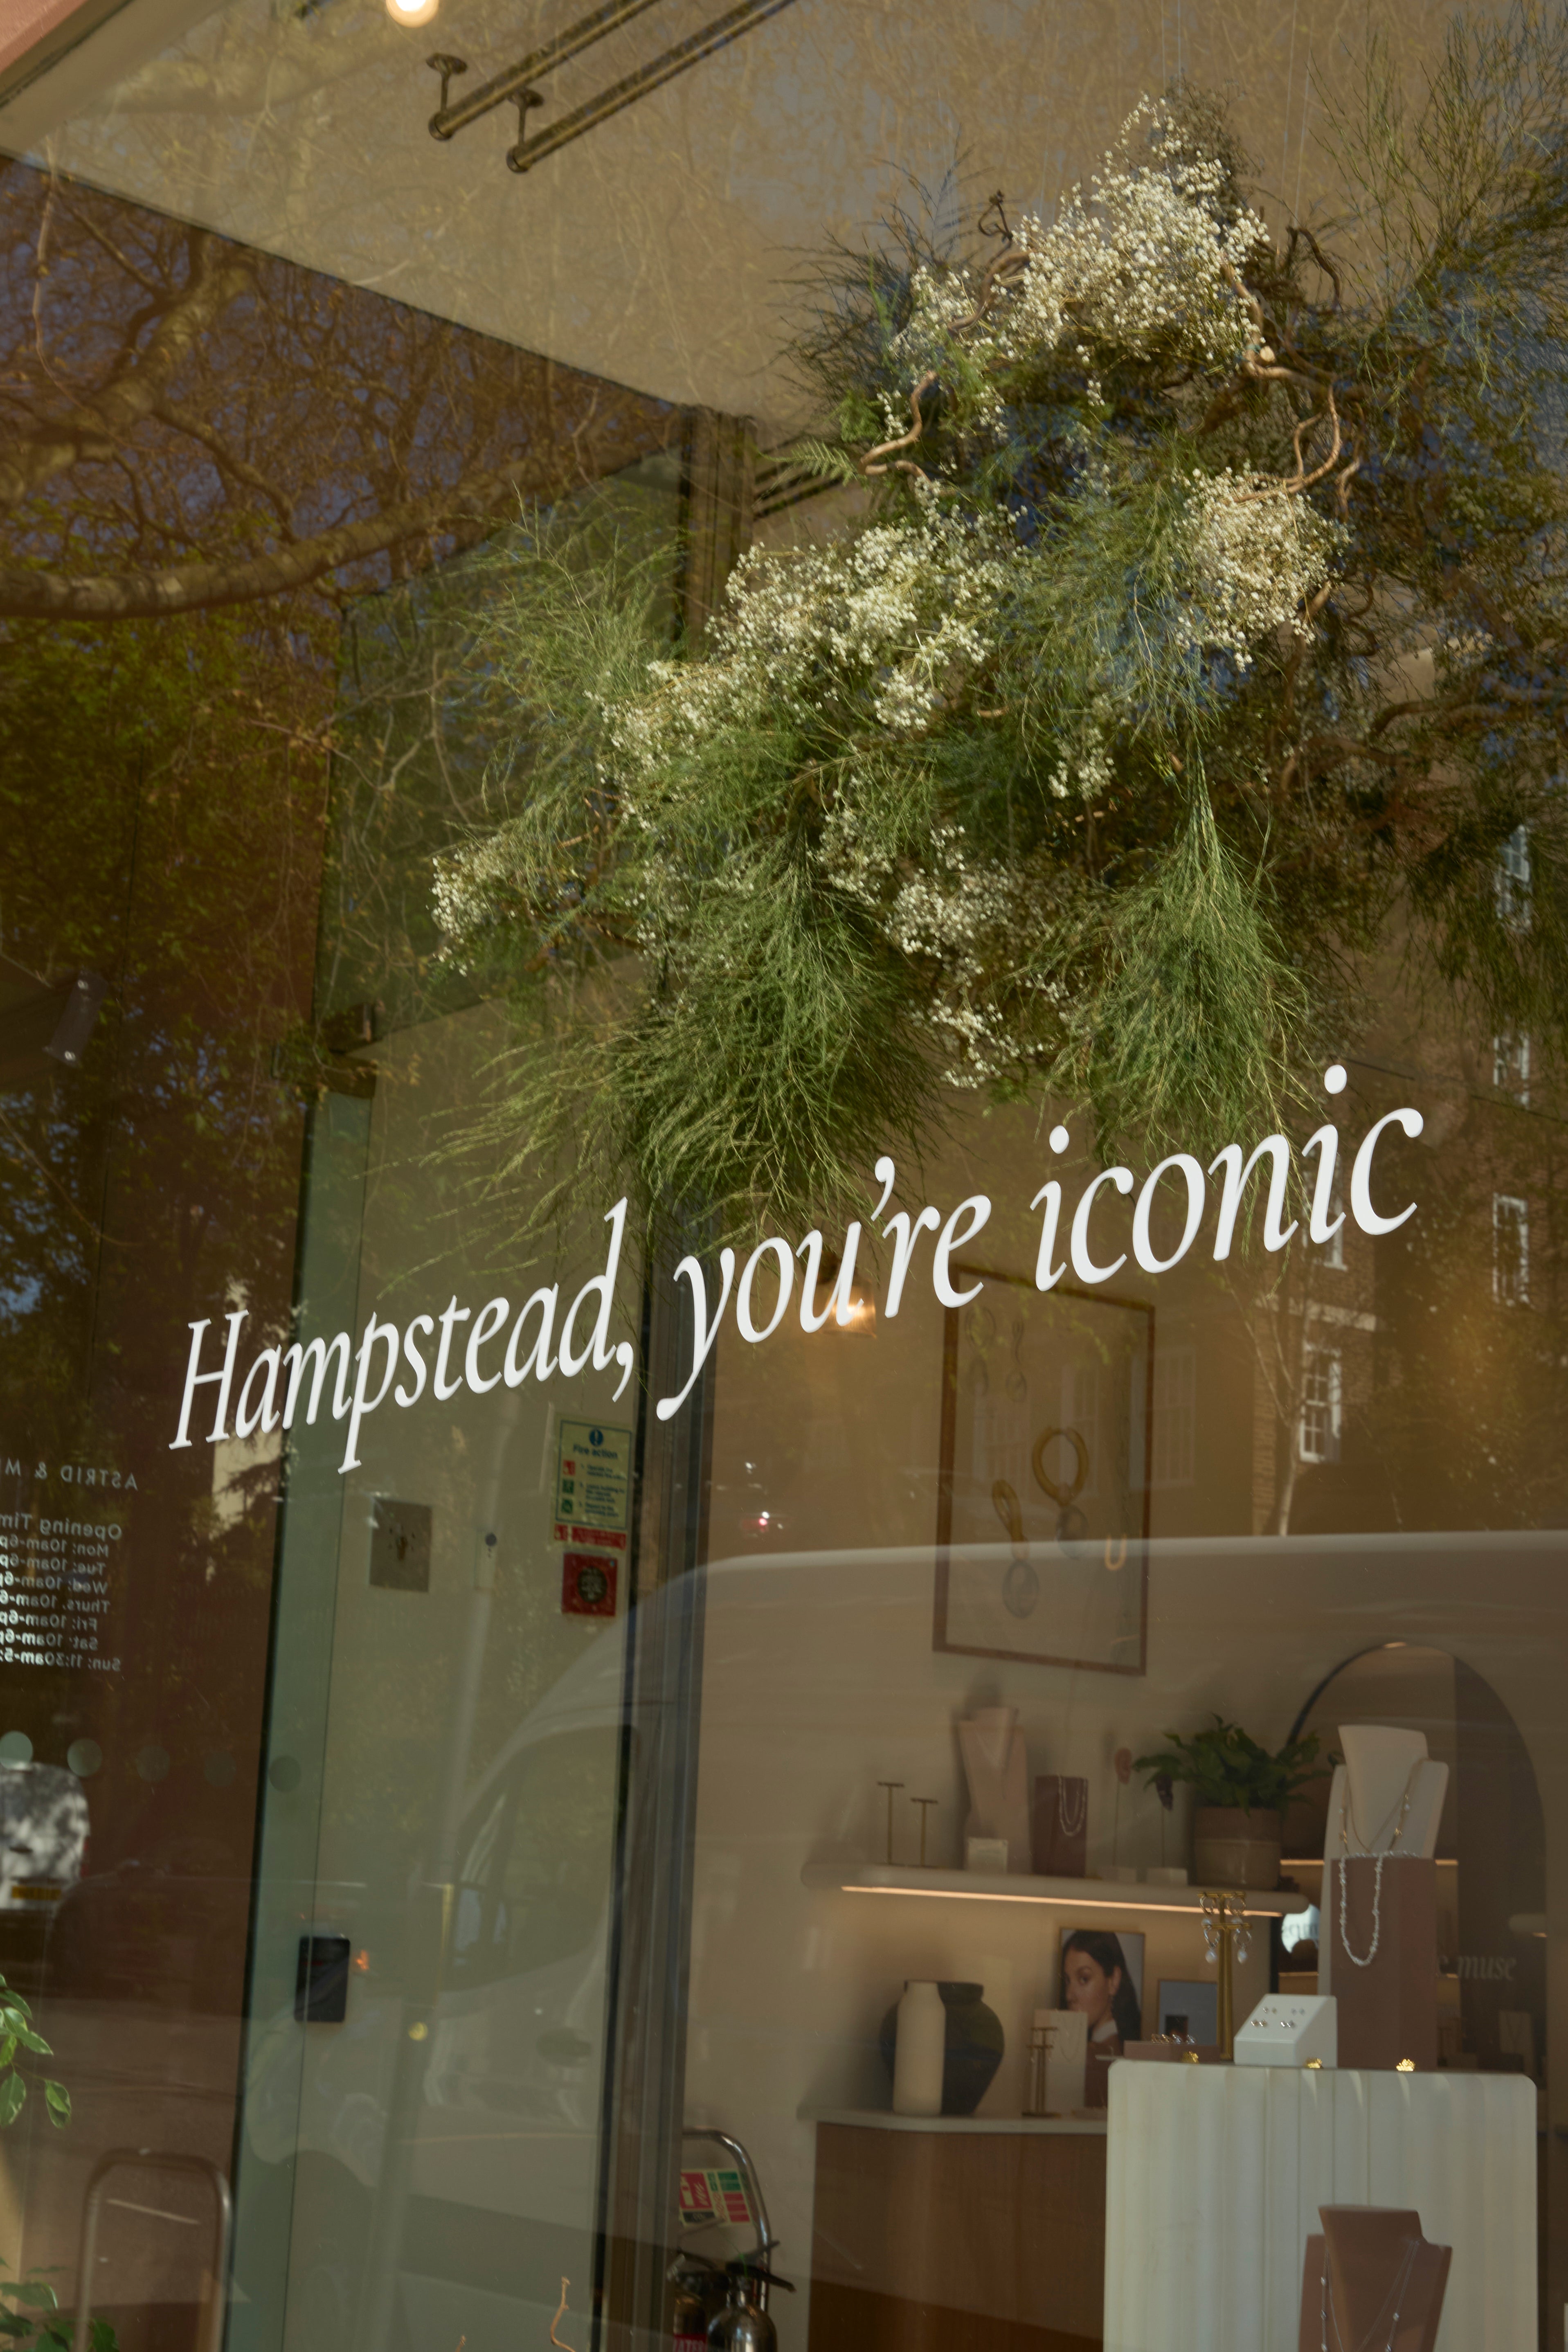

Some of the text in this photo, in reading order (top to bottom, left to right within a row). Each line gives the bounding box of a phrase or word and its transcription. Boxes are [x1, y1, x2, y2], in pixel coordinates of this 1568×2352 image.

[169, 1065, 1424, 1474] Hampstead, you’re iconic
